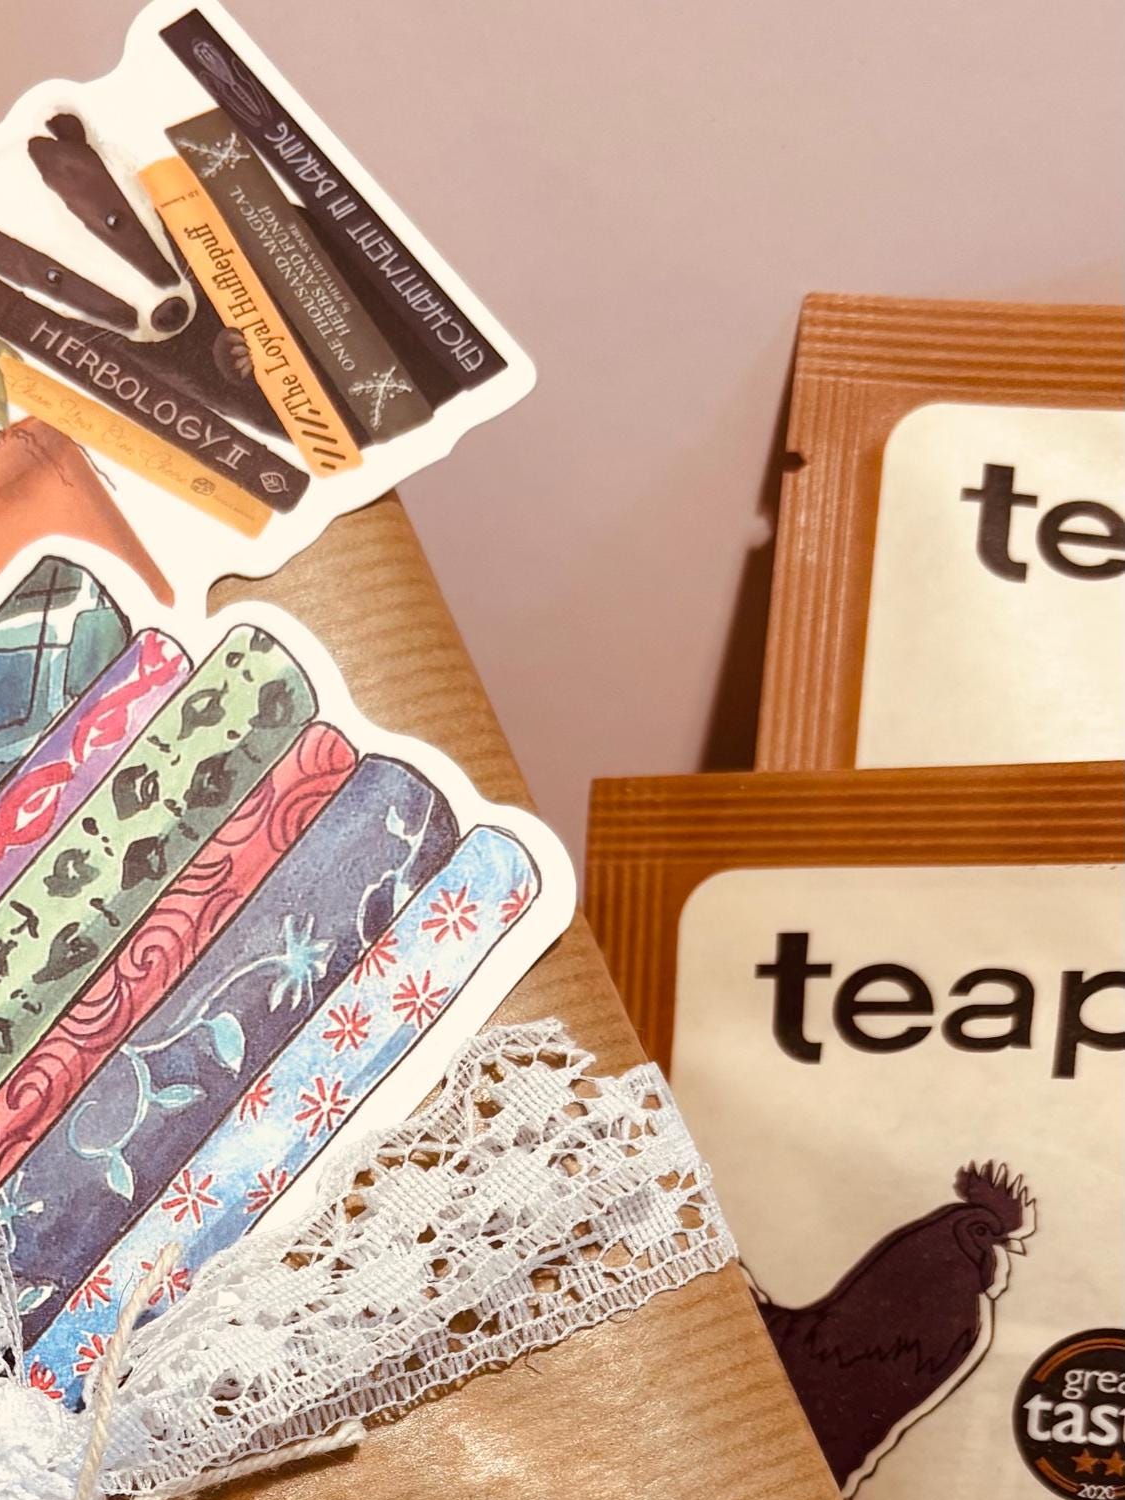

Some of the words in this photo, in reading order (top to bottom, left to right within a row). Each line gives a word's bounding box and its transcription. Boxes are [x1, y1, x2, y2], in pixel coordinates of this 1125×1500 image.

[265, 122, 336, 199] BAKING
[231, 185, 282, 258] MAGICAL
[262, 205, 295, 255] FUNGI
[327, 195, 358, 222] IN
[184, 222, 258, 323] Hufflepuff
[275, 255, 336, 339] THOUSAND
[288, 252, 319, 290] AND
[346, 221, 484, 373] ENCHANTMENT
[311, 288, 351, 337] HERBS
[241, 319, 290, 376] Loyal
[328, 339, 355, 372] ONE
[30, 321, 229, 449] HERBOLOGY
[281, 374, 313, 418] The
[1023, 1393, 1125, 1446] tas
[1077, 1483, 1116, 1500] 2020
